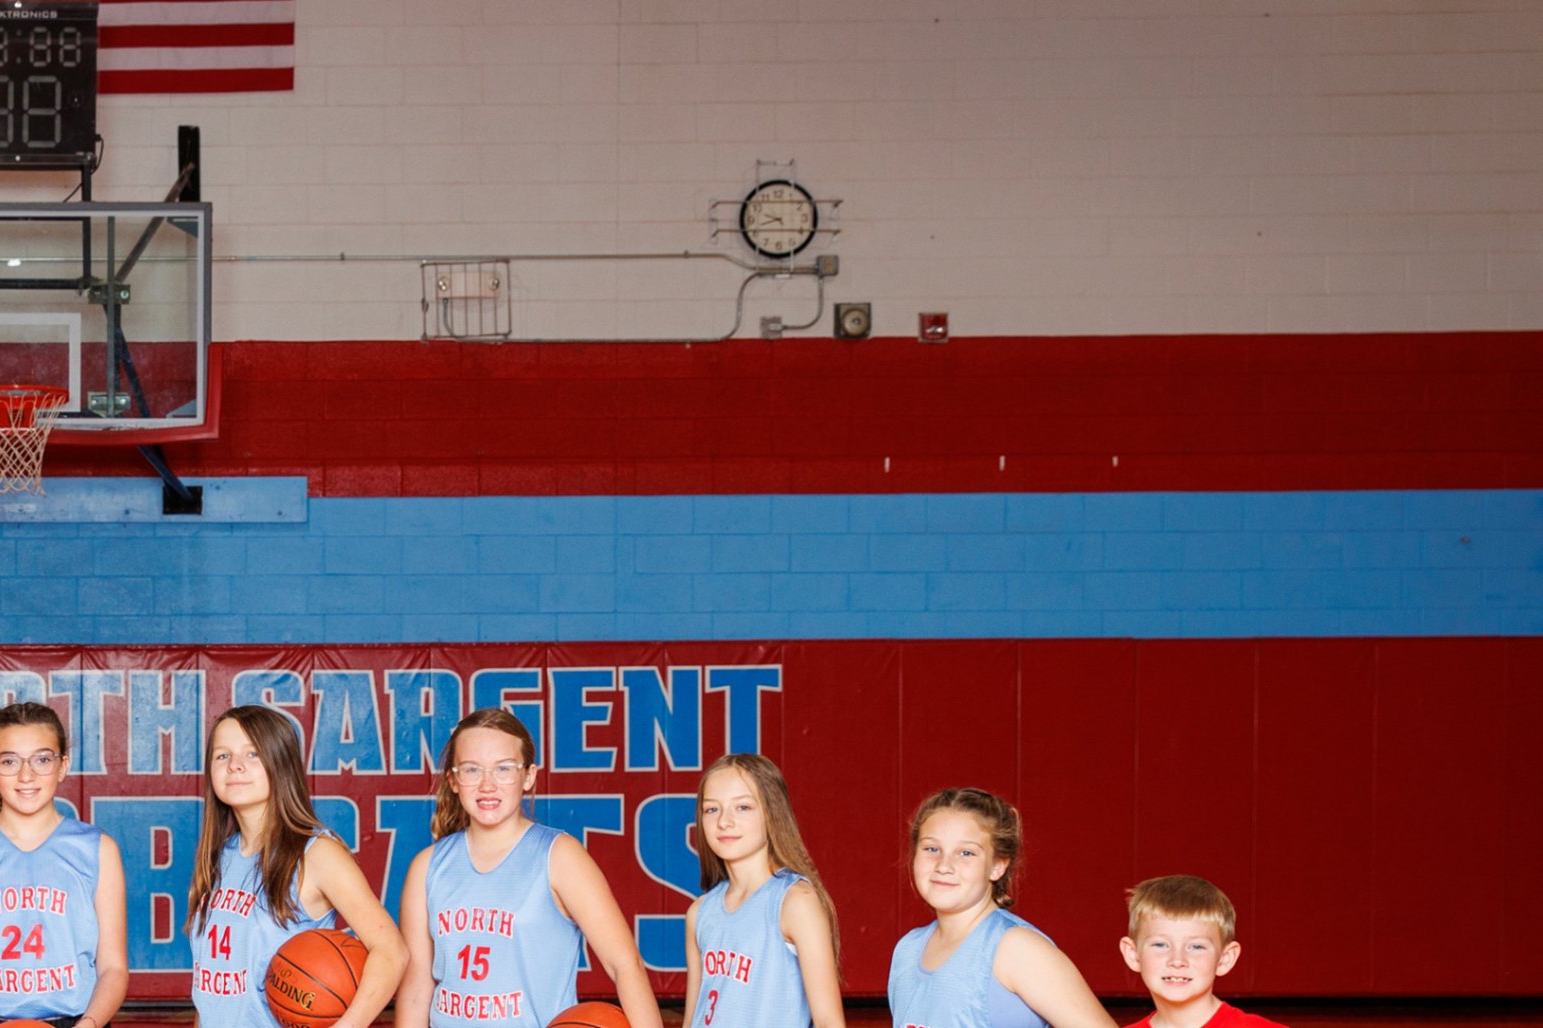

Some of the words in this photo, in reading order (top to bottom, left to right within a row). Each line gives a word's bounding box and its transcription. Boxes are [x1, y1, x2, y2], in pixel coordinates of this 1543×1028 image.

[437, 907, 515, 939] NORTH
[1, 924, 45, 960] 24
[208, 924, 232, 960] 14
[457, 944, 491, 982] 15
[436, 988, 523, 1021] ARGENT
[704, 990, 719, 1025] 3
